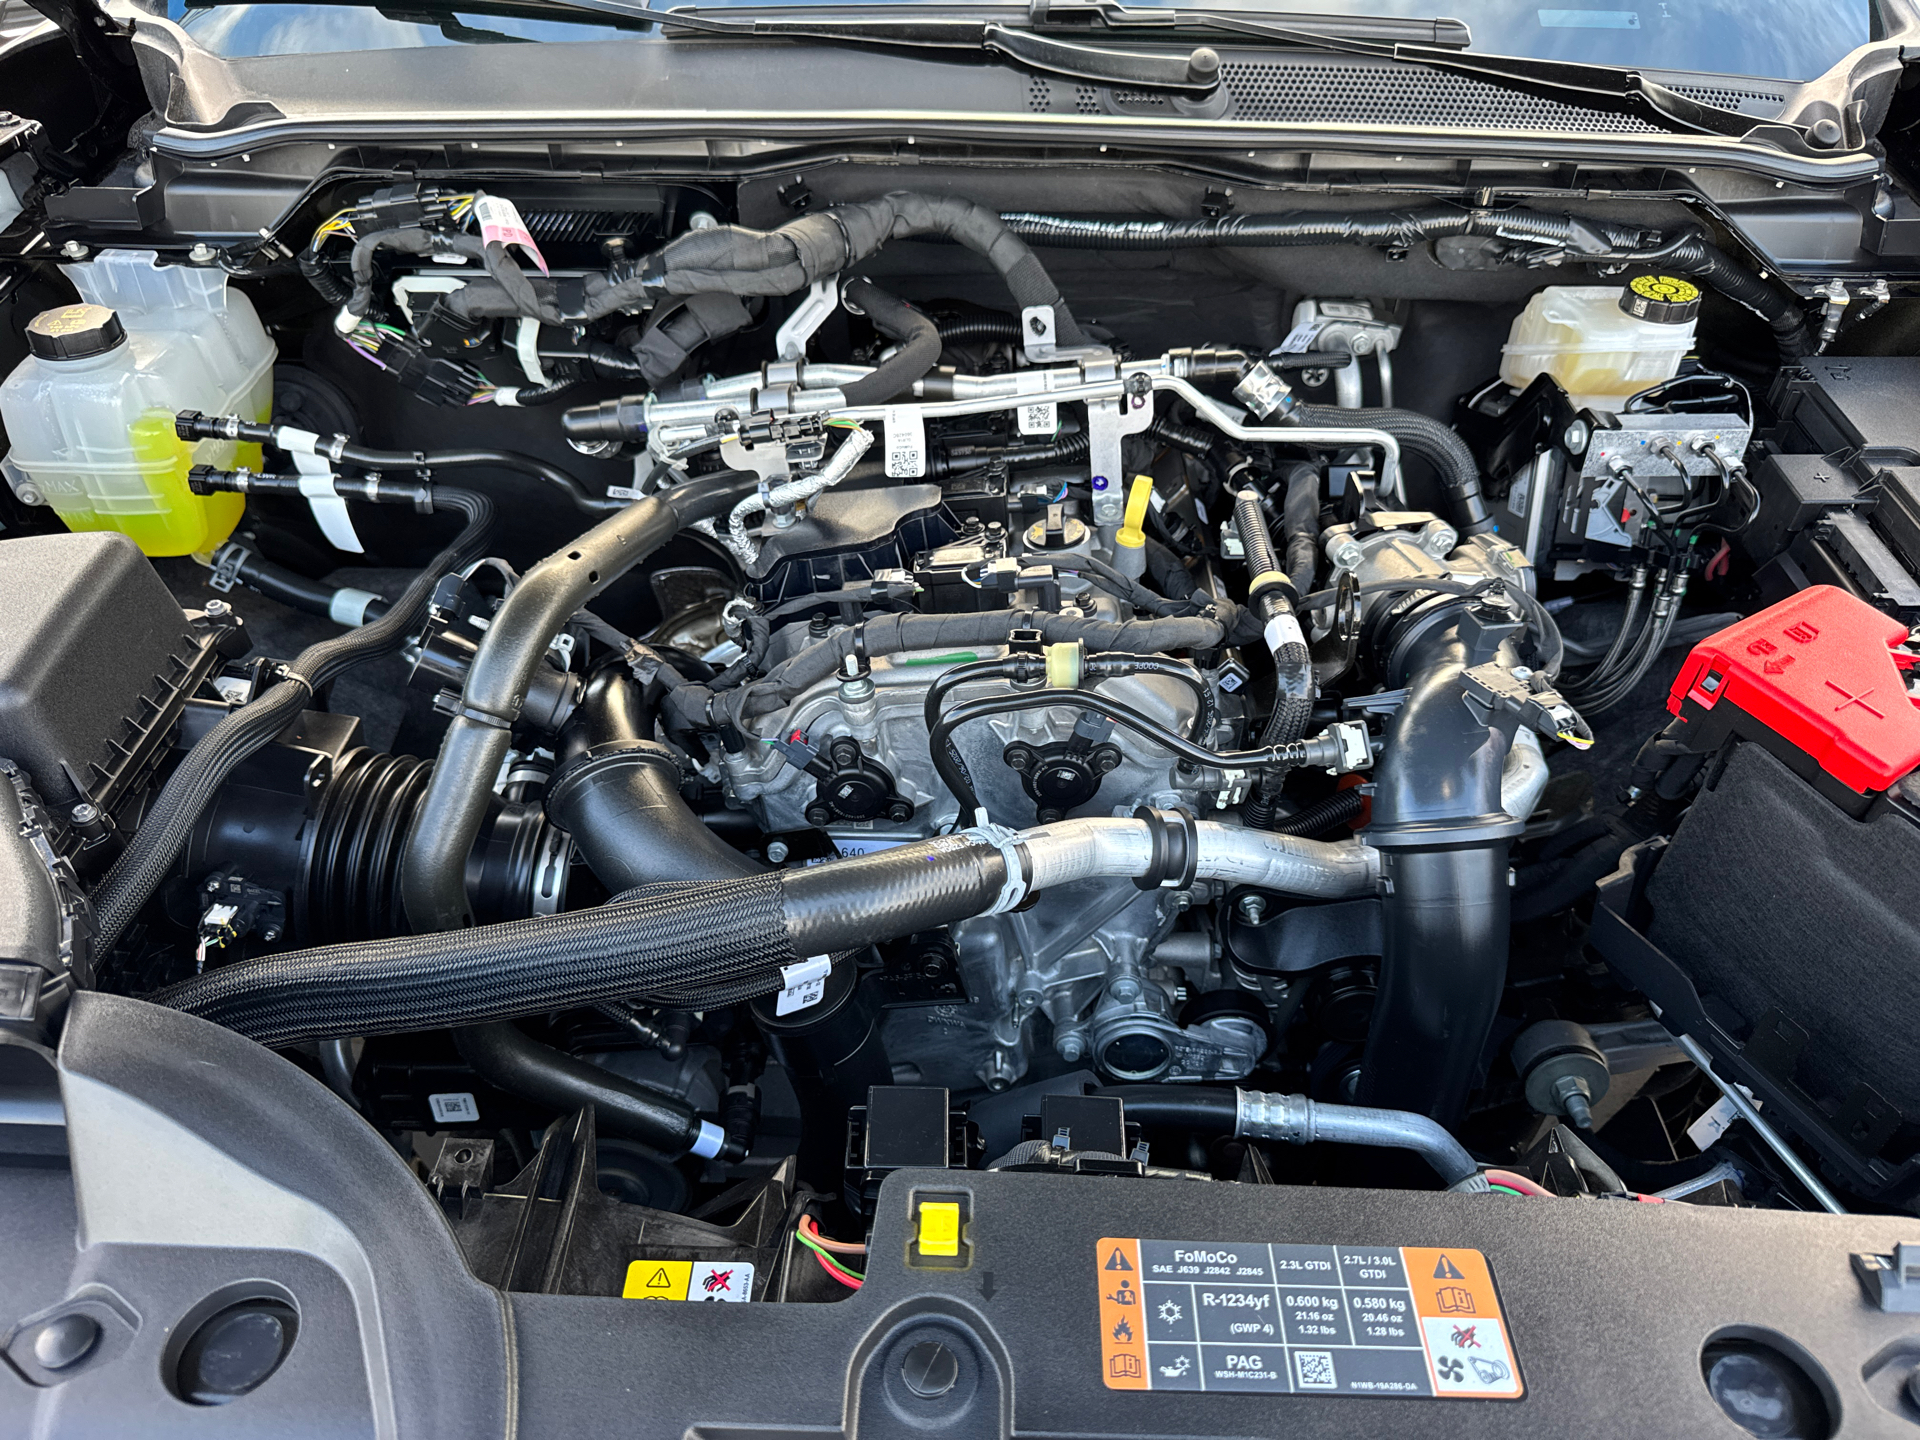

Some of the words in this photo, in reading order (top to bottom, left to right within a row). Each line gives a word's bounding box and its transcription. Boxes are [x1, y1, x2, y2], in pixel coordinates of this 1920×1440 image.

[44, 479, 79, 493] MAX
[841, 847, 865, 858] 640
[1174, 1250, 1238, 1264] FoMoCo
[1343, 1255, 1367, 1265] 2.7L
[1373, 1256, 1397, 1266] 3.0L
[1152, 1264, 1174, 1274] SAE
[1176, 1265, 1200, 1275] J639
[1203, 1266, 1231, 1275] J2842
[1235, 1267, 1264, 1276] J2845
[1280, 1260, 1303, 1270] 2.3L
[1304, 1261, 1332, 1270] GTDI
[1359, 1269, 1387, 1279] GTDI
[741, 1273, 750, 1302] A-8653-AA
[1202, 1292, 1270, 1310] R-1234yf
[1286, 1295, 1319, 1307] 0.600
[1321, 1296, 1339, 1310] kg
[1353, 1297, 1387, 1309] 0.580
[1389, 1298, 1406, 1312] kg
[1295, 1311, 1320, 1321] 21.16
[1321, 1313, 1335, 1321] oz
[1362, 1313, 1389, 1322] 20.46
[1390, 1315, 1403, 1323] oz
[1230, 1323, 1261, 1335] (GWP
[1261, 1324, 1274, 1336] 4)
[1298, 1325, 1319, 1334] 1.32
[1320, 1325, 1337, 1335] lbs
[1366, 1326, 1387, 1336] 1.28
[1388, 1327, 1405, 1336] lbs
[1226, 1354, 1263, 1370] PAG
[1214, 1370, 1278, 1380] WSH-M1C231-B
